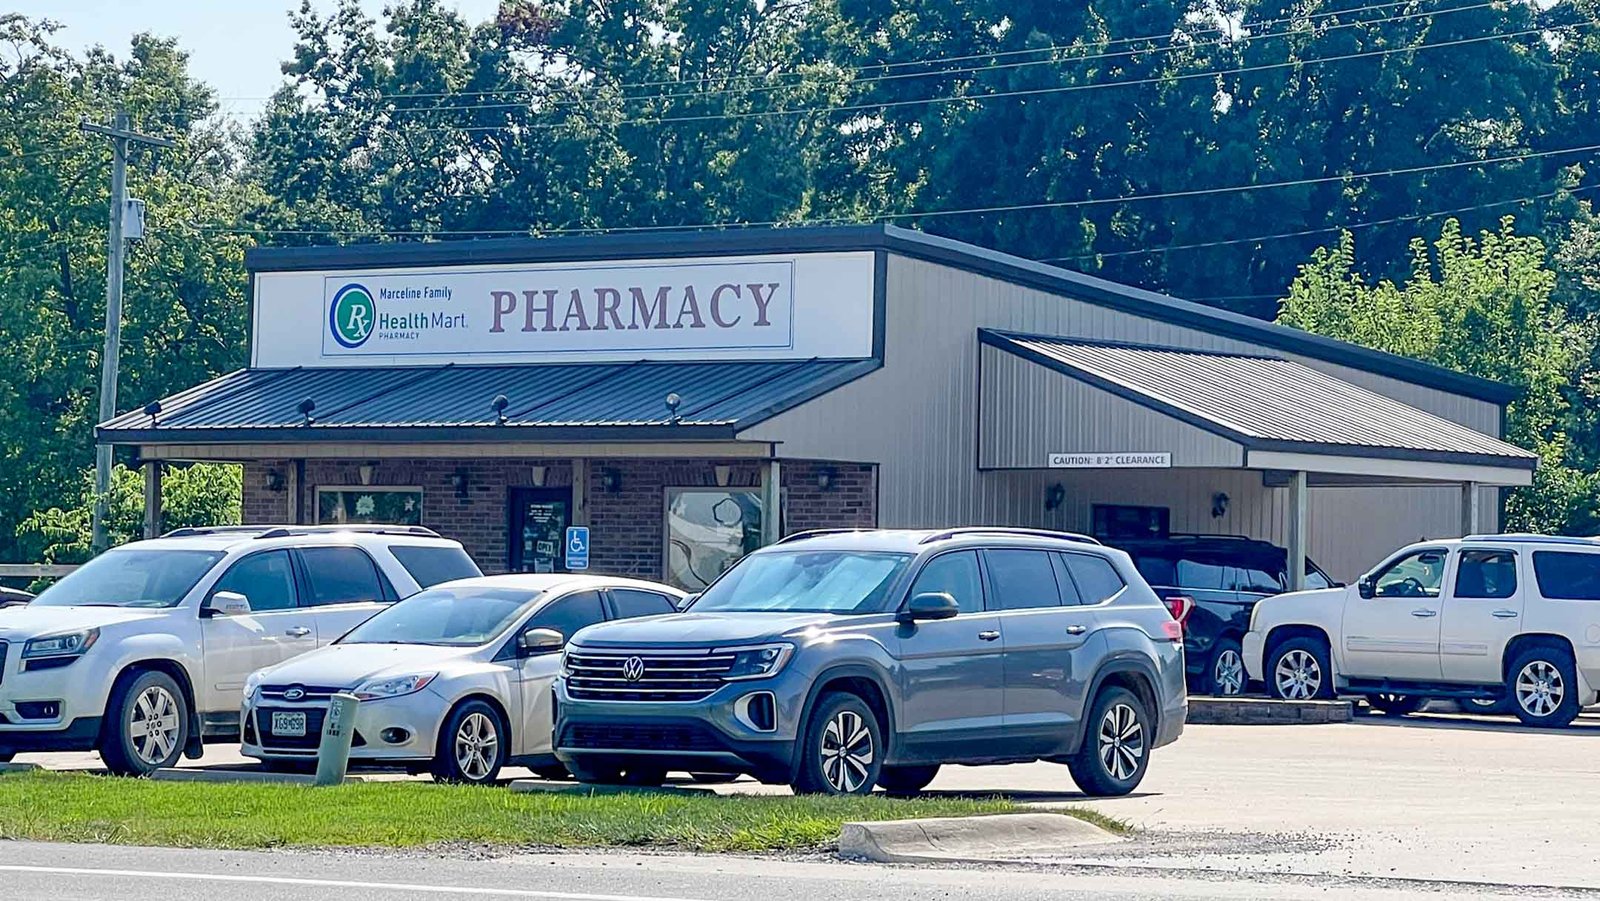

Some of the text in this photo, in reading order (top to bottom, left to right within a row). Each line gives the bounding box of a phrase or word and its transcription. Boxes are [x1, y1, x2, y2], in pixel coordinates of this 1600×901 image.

[380, 286, 453, 301] Marceline Family
[489, 283, 780, 333] PHARMACY
[379, 312, 428, 329] Health
[379, 332, 420, 340] PHARMACY
[1115, 455, 1165, 465] CLEARANCE
